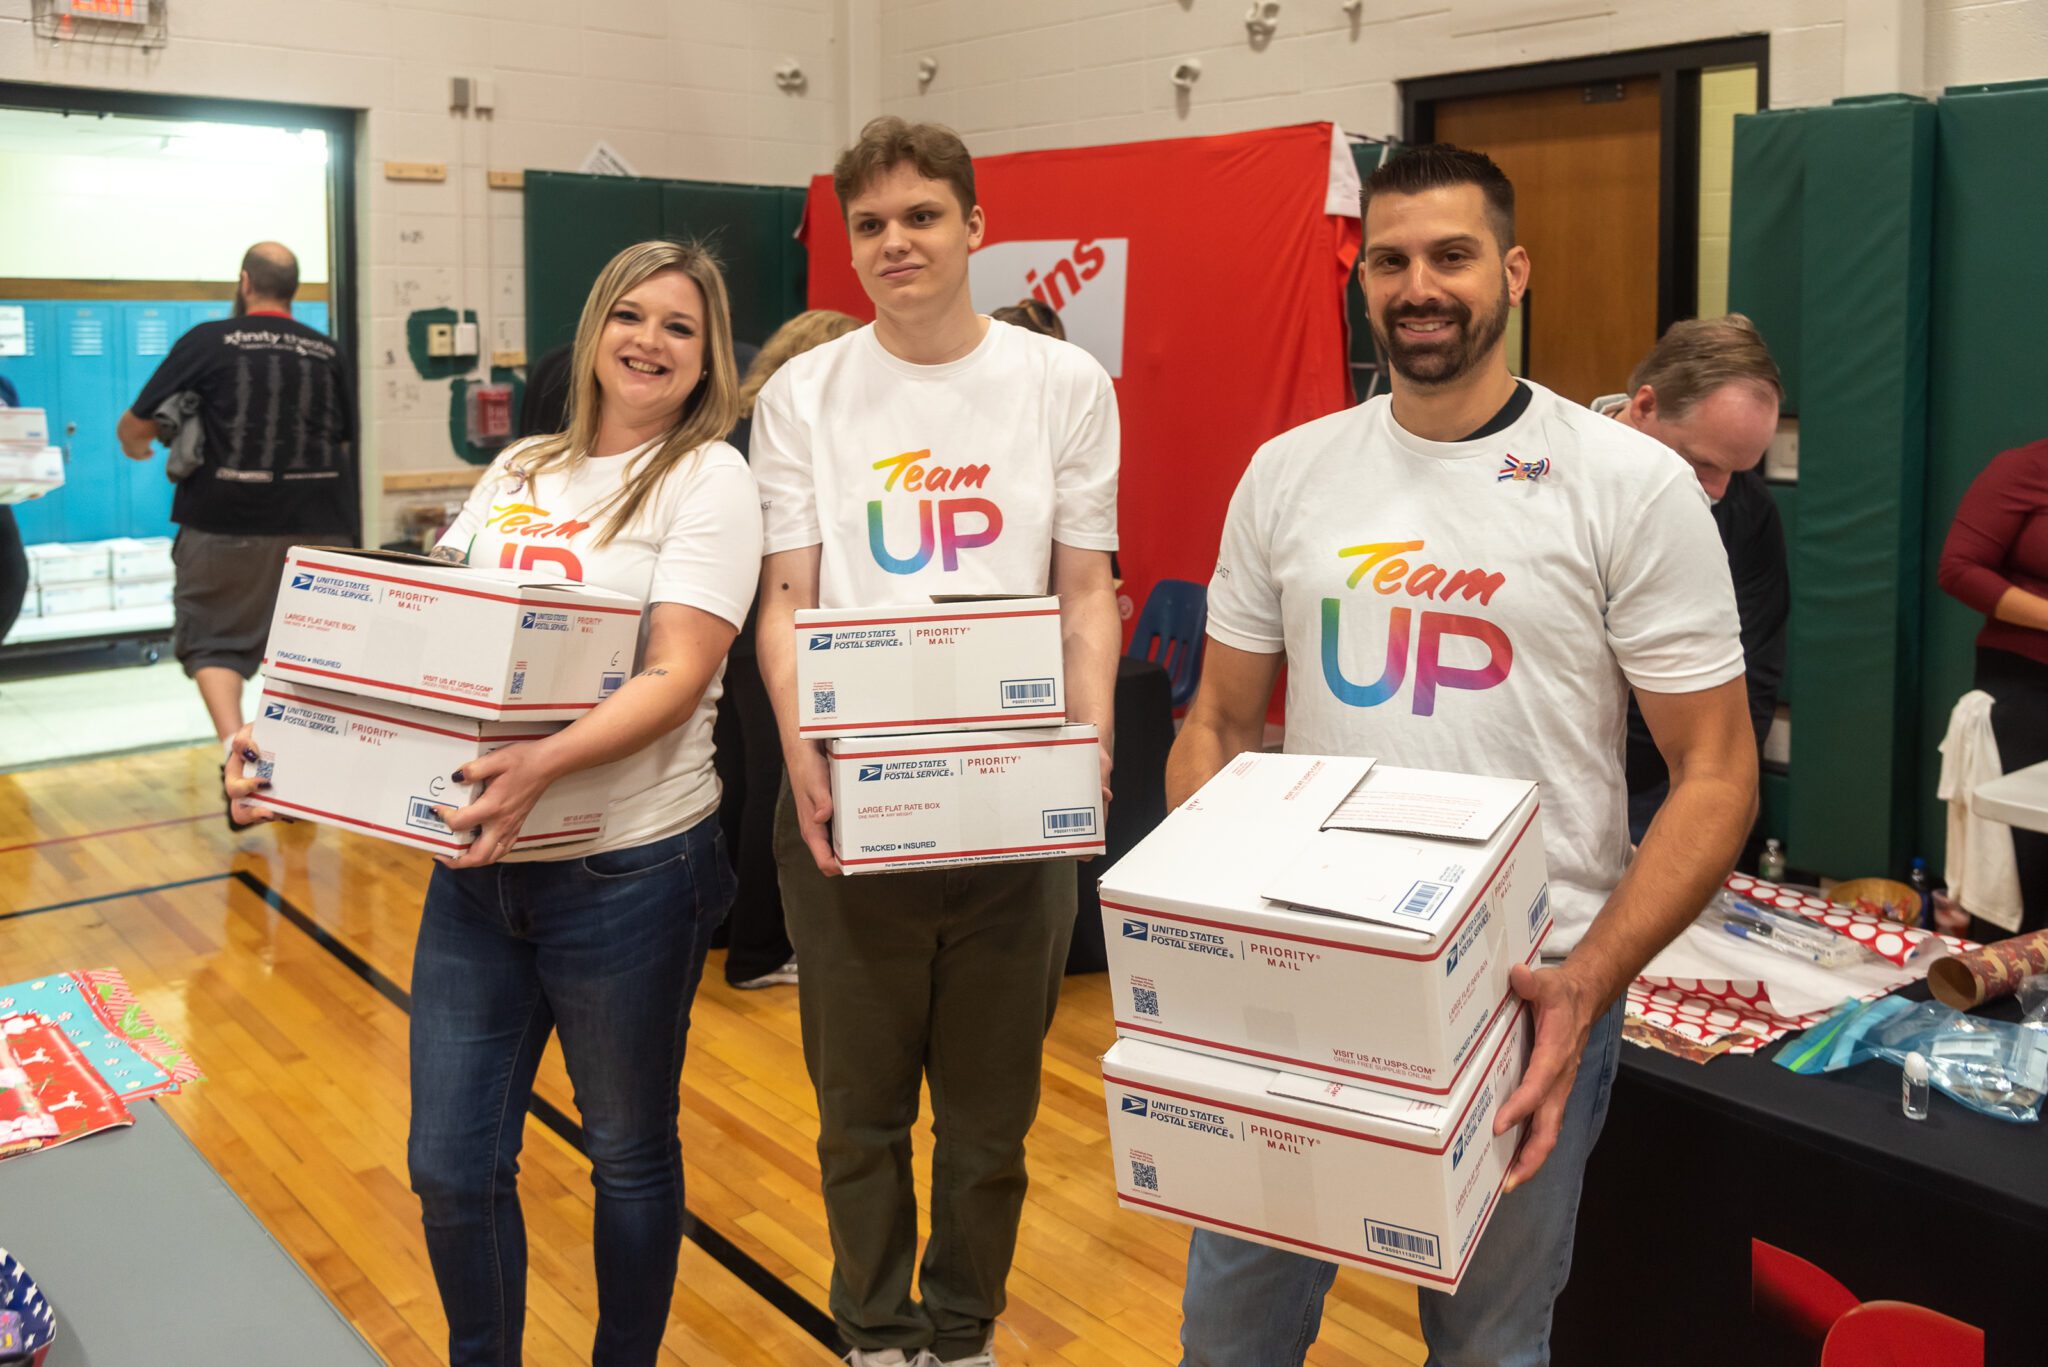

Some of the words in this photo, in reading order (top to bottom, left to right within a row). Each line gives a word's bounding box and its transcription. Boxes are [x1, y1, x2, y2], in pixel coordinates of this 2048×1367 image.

[1025, 238, 1105, 313] ins
[872, 448, 991, 493] Team
[485, 503, 591, 539] Team
[867, 497, 1004, 575] UP
[1338, 540, 1506, 607] Team
[316, 576, 344, 587] UNITED
[344, 580, 370, 592] STATES
[312, 585, 339, 597] POSTAL
[340, 590, 370, 602] SERVICE
[389, 589, 434, 604] PRIORITY
[398, 601, 422, 611] MAIL
[284, 613, 306, 623] LARGE
[307, 616, 323, 626] FLAT
[324, 619, 340, 629] RATE
[341, 622, 357, 632] BOX
[835, 630, 866, 640] UNITED
[867, 629, 896, 638] STATES
[916, 627, 967, 637] PRIORITY
[834, 640, 864, 650] POSTAL
[865, 639, 899, 648] SERVICE
[929, 637, 955, 645] MAIL
[277, 651, 306, 663] TRACKED
[312, 657, 341, 669] INSURED
[1321, 597, 1513, 717] UP
[287, 706, 311, 718] UNITED
[312, 712, 336, 724] STATES
[283, 715, 308, 728] POSTAL
[308, 721, 336, 734] SERVICE
[351, 723, 394, 739] PRIORITY
[360, 735, 382, 746] MAIL
[885, 761, 917, 770] UNITED
[918, 760, 947, 768] STATES
[967, 756, 1017, 767] PRIORITY
[884, 771, 915, 780] POSTAL
[916, 769, 949, 778] SERVICE
[980, 766, 1006, 775] MAIL
[858, 806, 883, 814] LARGE
[885, 804, 902, 812] FLAT
[904, 803, 922, 811] RATE
[925, 802, 941, 810] BOX
[860, 844, 896, 853] TRACKED
[903, 841, 936, 850] INSURED
[1151, 924, 1188, 938] UNITED
[1190, 931, 1224, 944] STATES
[1151, 936, 1186, 950] POSTAL
[1188, 942, 1229, 958] SERVICE
[1251, 943, 1315, 963] PRIORITY
[1267, 958, 1301, 971] MAIL
[1333, 1049, 1354, 1059] VISIT
[1357, 1054, 1369, 1062] US
[1371, 1056, 1382, 1065] AT
[1384, 1058, 1432, 1075] USPS.COM
[1333, 1056, 1356, 1066] ORDER
[1357, 1060, 1373, 1070] FREE
[1375, 1064, 1406, 1075] SUPPLIES
[1407, 1070, 1432, 1081] ONLINE
[1151, 1100, 1189, 1116] UNITED
[1190, 1108, 1224, 1124] STATES
[1150, 1112, 1186, 1127] POSTAL
[1188, 1120, 1228, 1138] SERVICE
[1251, 1124, 1315, 1147] PRIORITY
[1267, 1139, 1301, 1155] MAIL
